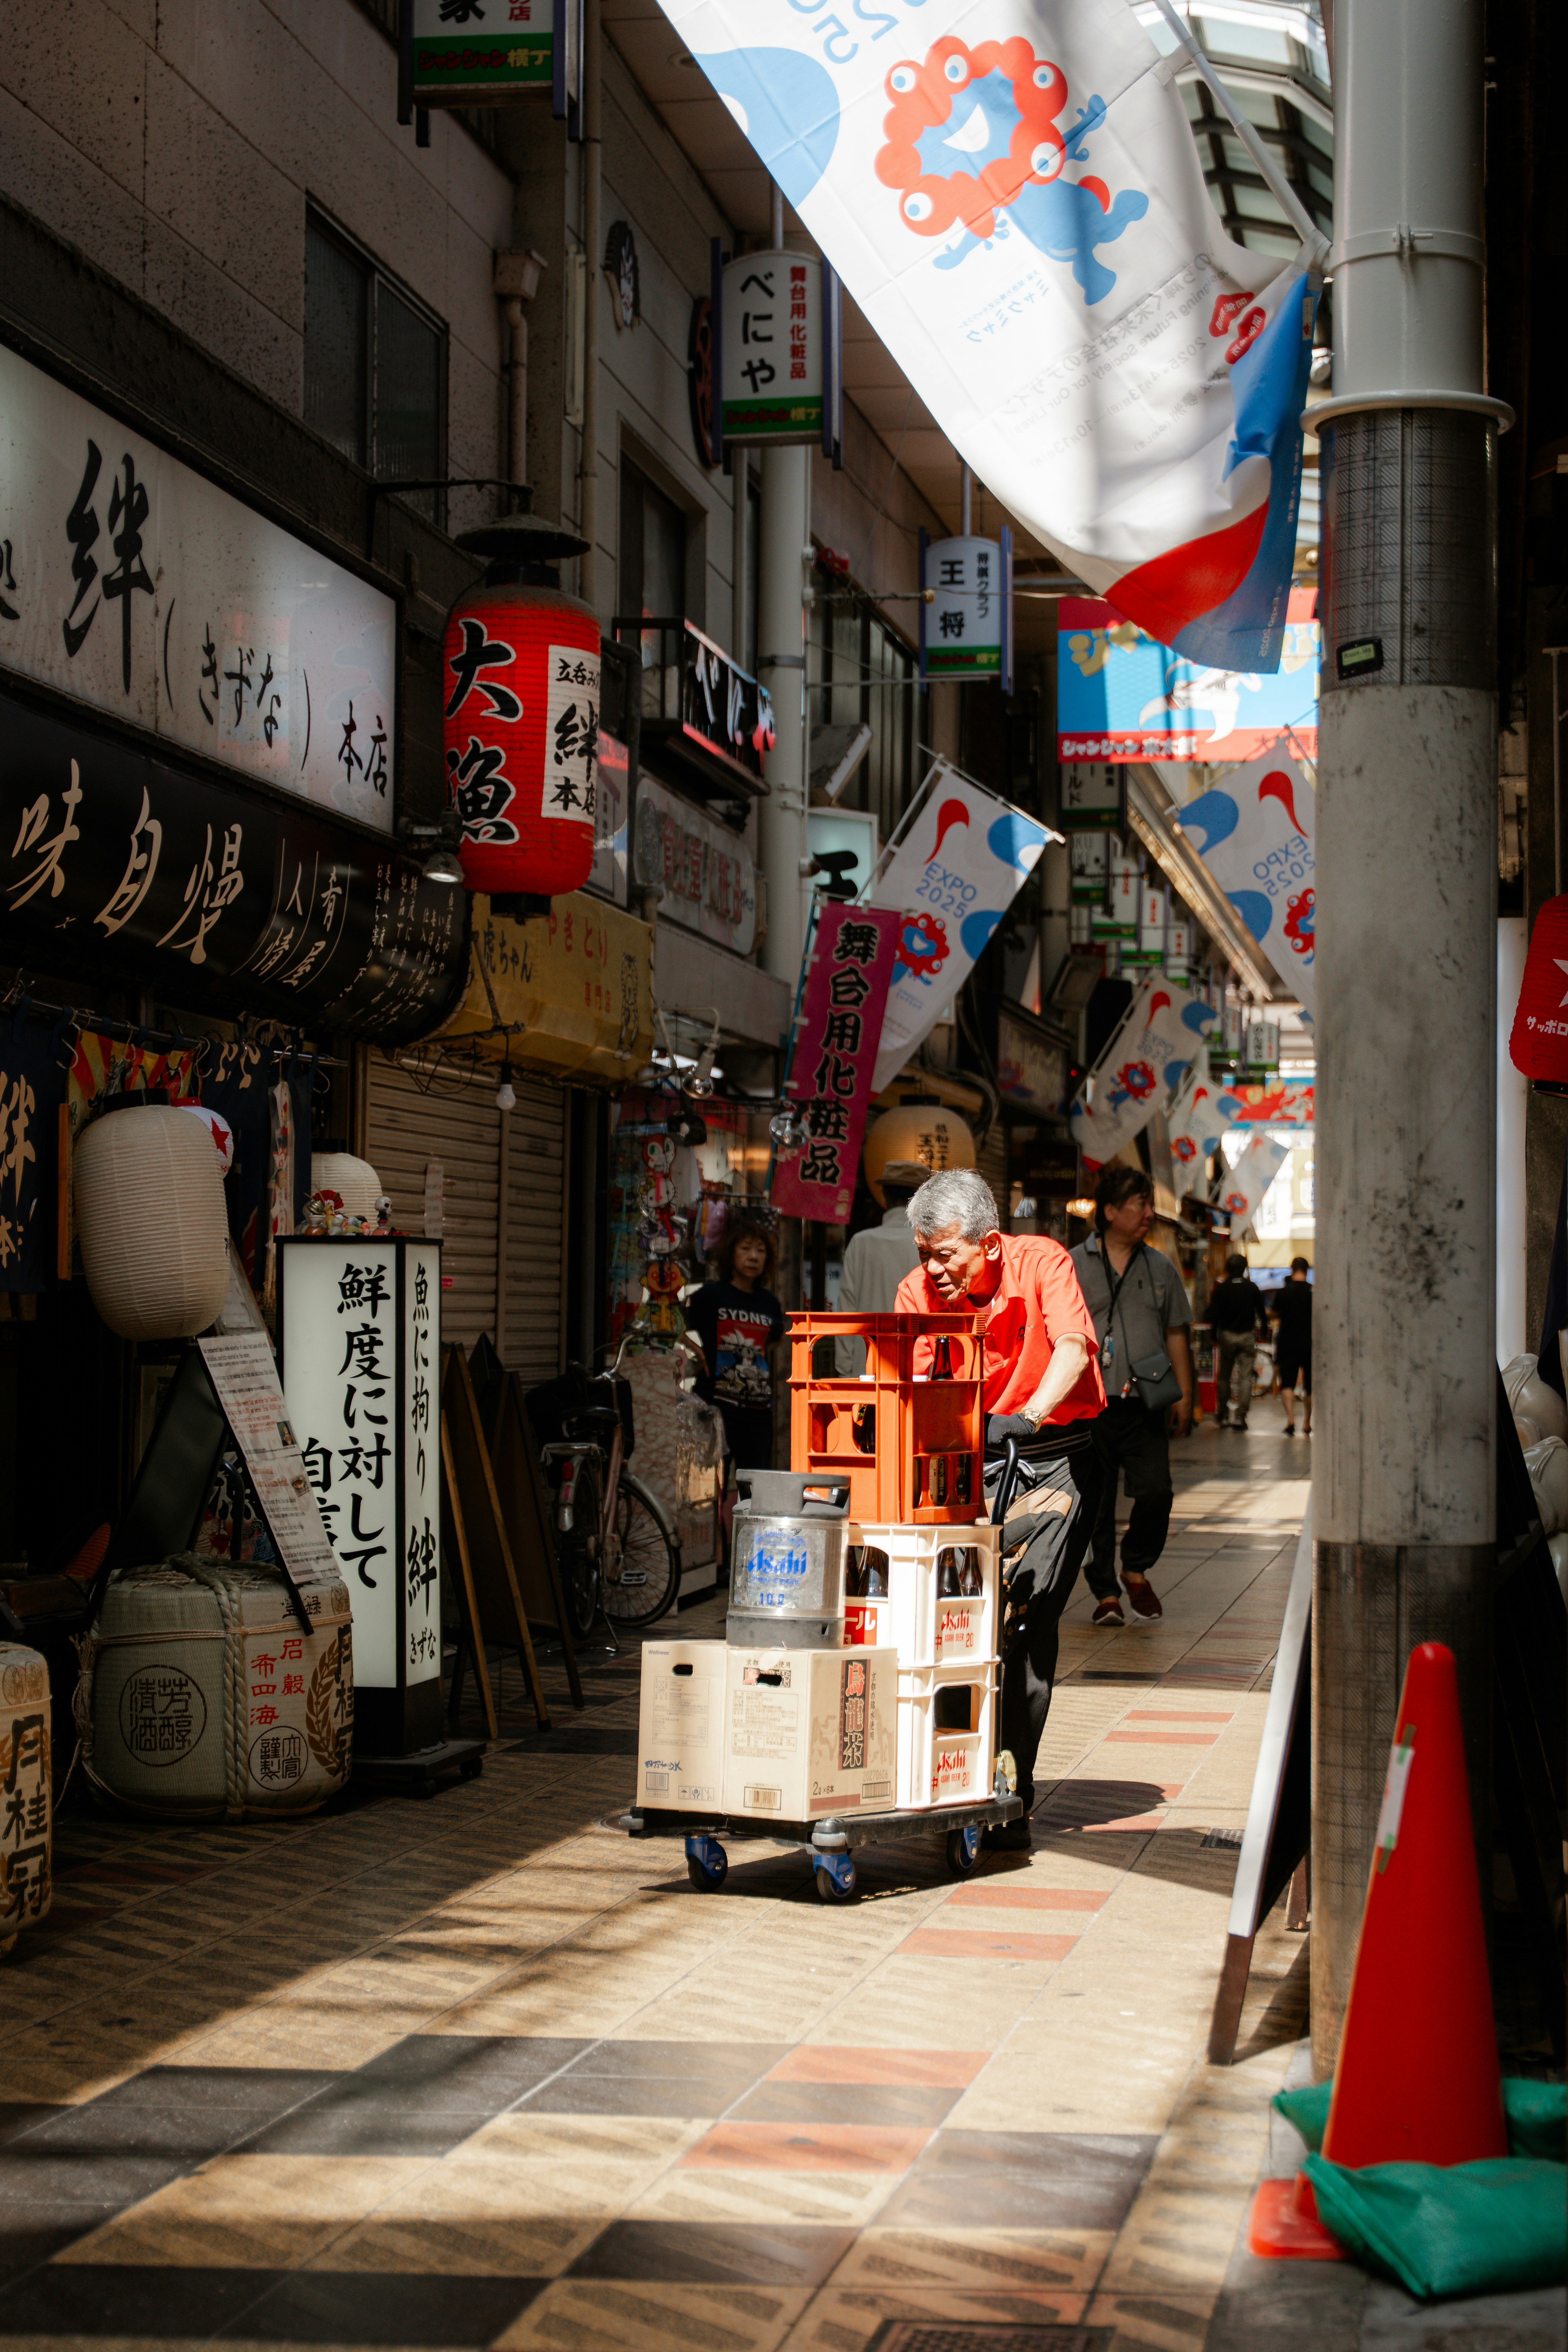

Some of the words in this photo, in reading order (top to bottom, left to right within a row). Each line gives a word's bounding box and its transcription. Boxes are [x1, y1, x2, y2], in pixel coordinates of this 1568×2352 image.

[418, 47, 552, 72] ジャンジャン横丁
[738, 272, 775, 393] べにや
[789, 266, 807, 380] 舞台用化粧品
[63, 438, 154, 696] 絆
[338, 700, 388, 799] 本店
[939, 560, 966, 639] 王将
[445, 618, 524, 845] 大漁
[553, 700, 597, 782] 絆
[1062, 739, 1139, 757] ジャンジャン
[549, 777, 595, 815] 本店
[5, 758, 244, 965] 味自慢
[924, 861, 977, 902] EXPO
[915, 878, 968, 919] 2025
[483, 917, 533, 984] 虎ちゃん
[546, 903, 608, 967] やきとり
[584, 982, 611, 1014] 専門店
[799, 920, 879, 1185] 舞台用化粧品
[717, 1306, 774, 1327] SYDNEY
[411, 1261, 430, 1498] 魚に拘り
[336, 1263, 392, 1590] 鮮度に対して
[407, 1516, 438, 1618] 絆
[747, 1548, 807, 1575] Asahi
[941, 1608, 970, 1632] Asahi
[944, 1633, 954, 1643] ASAHI
[955, 1633, 964, 1642] BEER
[965, 1632, 974, 1648] 20
[409, 1627, 436, 1666] きずな
[934, 1634, 942, 1650] 中
[746, 1659, 791, 1669] 京都使用
[937, 1748, 966, 1774] Asahi
[940, 1775, 950, 1784] ASAHI
[951, 1774, 960, 1782] BEER
[962, 1771, 971, 1787] 20
[931, 1776, 939, 1792] 中
[2, 1714, 48, 1924] 月桂冠
